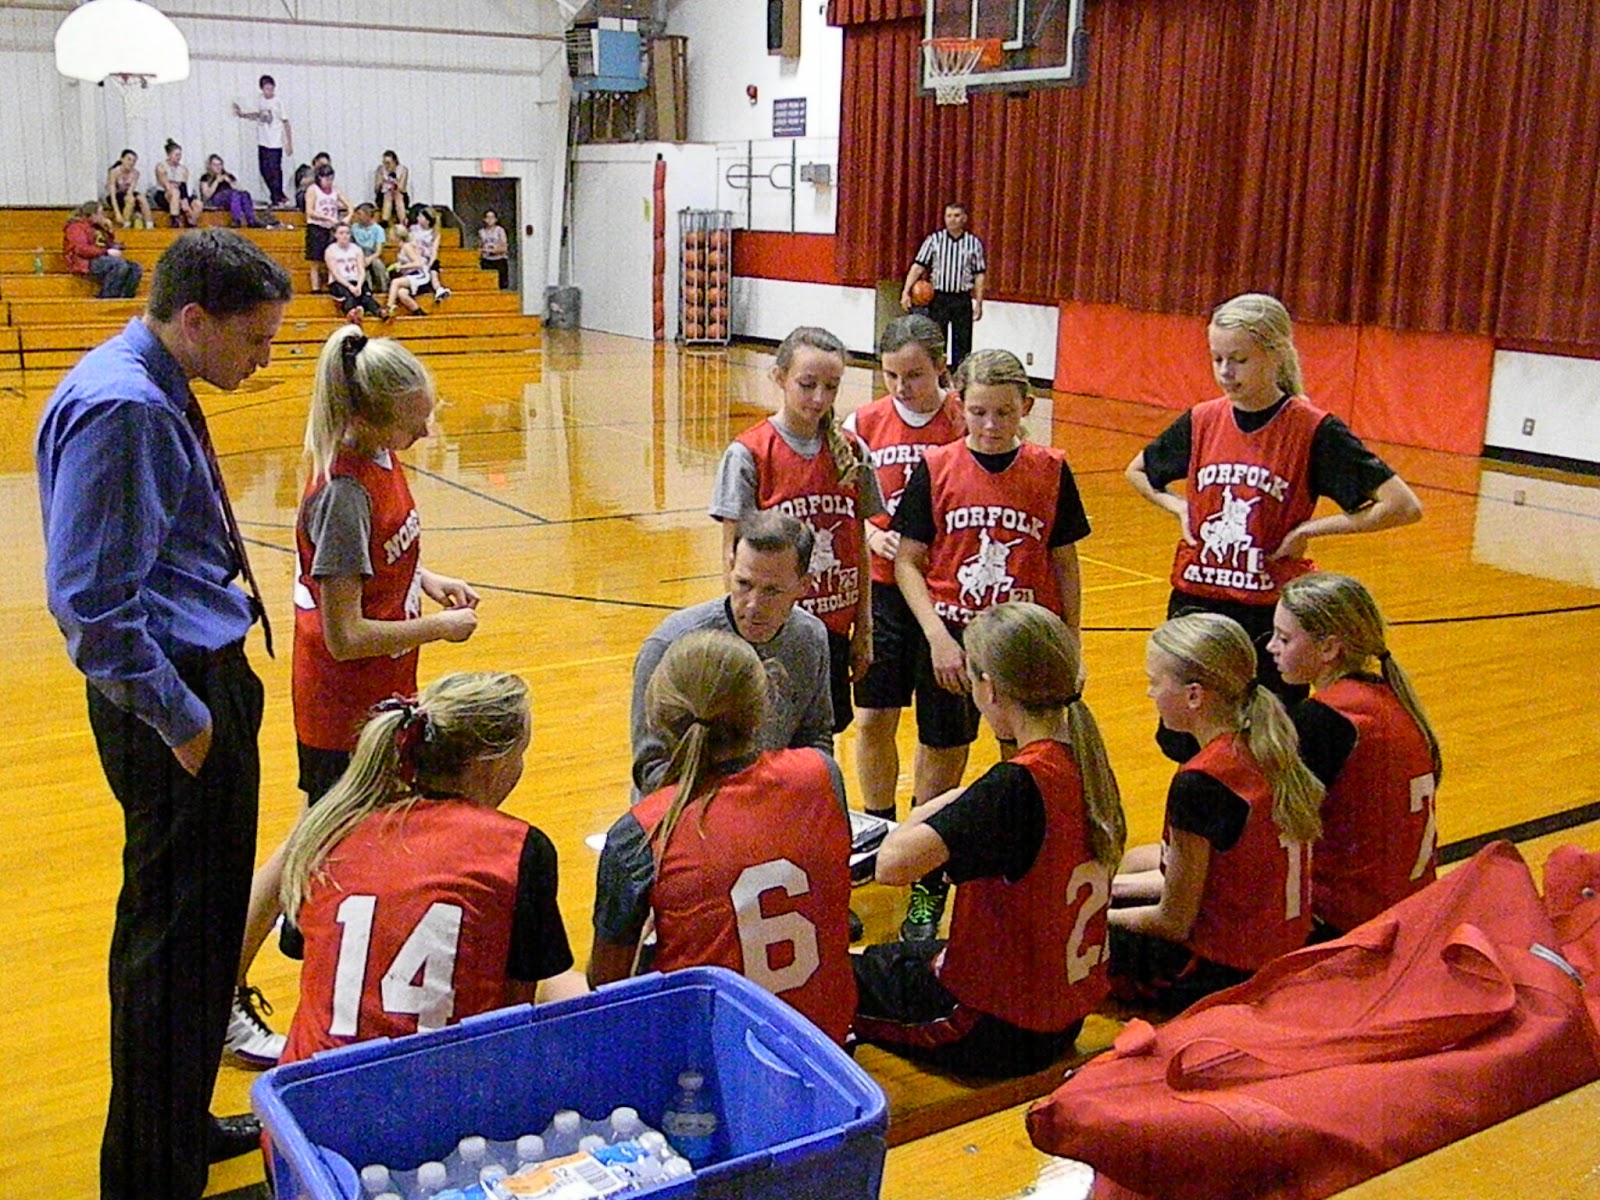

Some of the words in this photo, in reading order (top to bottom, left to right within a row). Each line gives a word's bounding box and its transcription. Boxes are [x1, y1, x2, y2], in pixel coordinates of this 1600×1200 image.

[870, 444, 939, 468] NORF
[772, 495, 854, 519] ORFOLK
[796, 590, 859, 614] THOLIC
[934, 601, 986, 623] CAT
[730, 858, 820, 995] 6
[1066, 860, 1112, 986] 2
[329, 895, 463, 1036] 14
